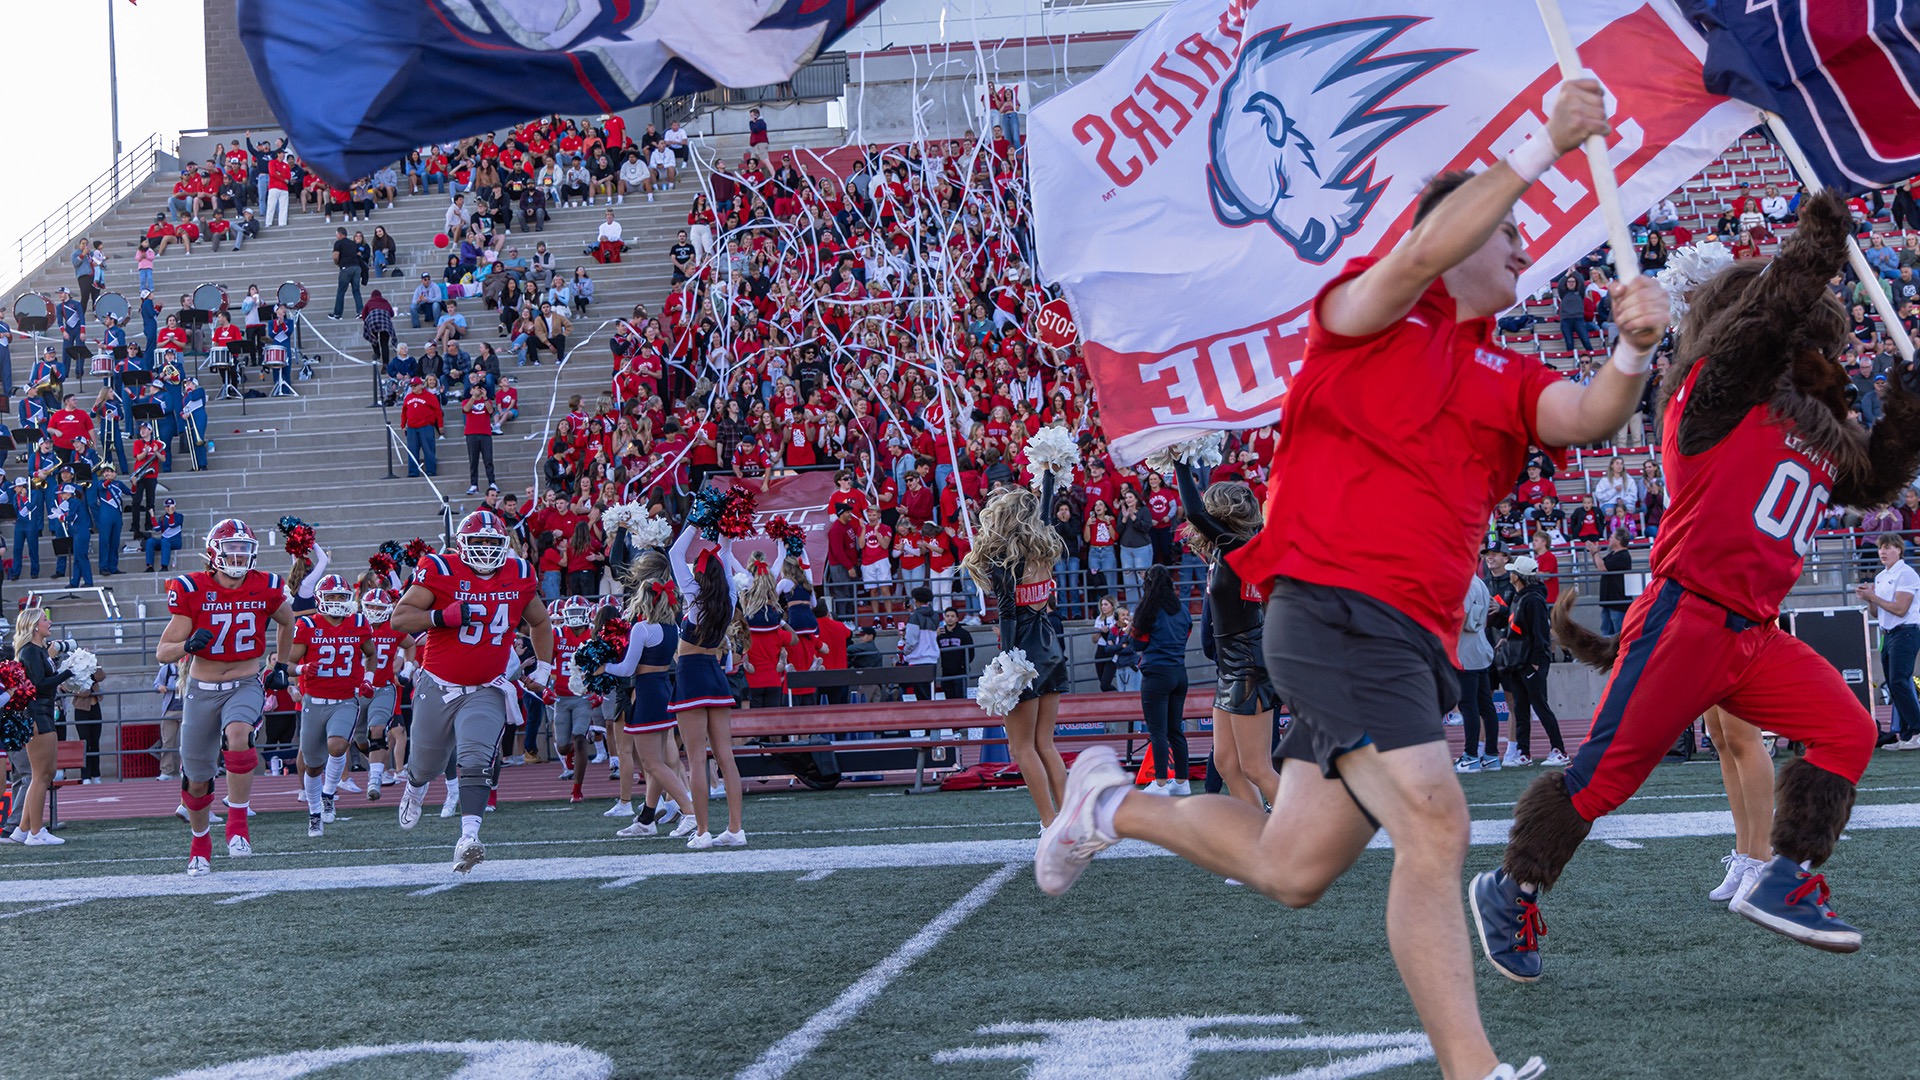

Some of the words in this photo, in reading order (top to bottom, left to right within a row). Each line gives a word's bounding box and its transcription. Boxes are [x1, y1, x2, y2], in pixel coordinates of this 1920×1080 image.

[1040, 309, 1076, 338] STOP
[1752, 458, 1831, 557] 00
[202, 602, 232, 611] UTAH
[235, 601, 266, 610] TECH
[455, 591, 487, 601] UTAH
[490, 591, 519, 600] TECH
[210, 612, 256, 655] 72
[458, 603, 510, 647] 64
[317, 645, 355, 677] 23
